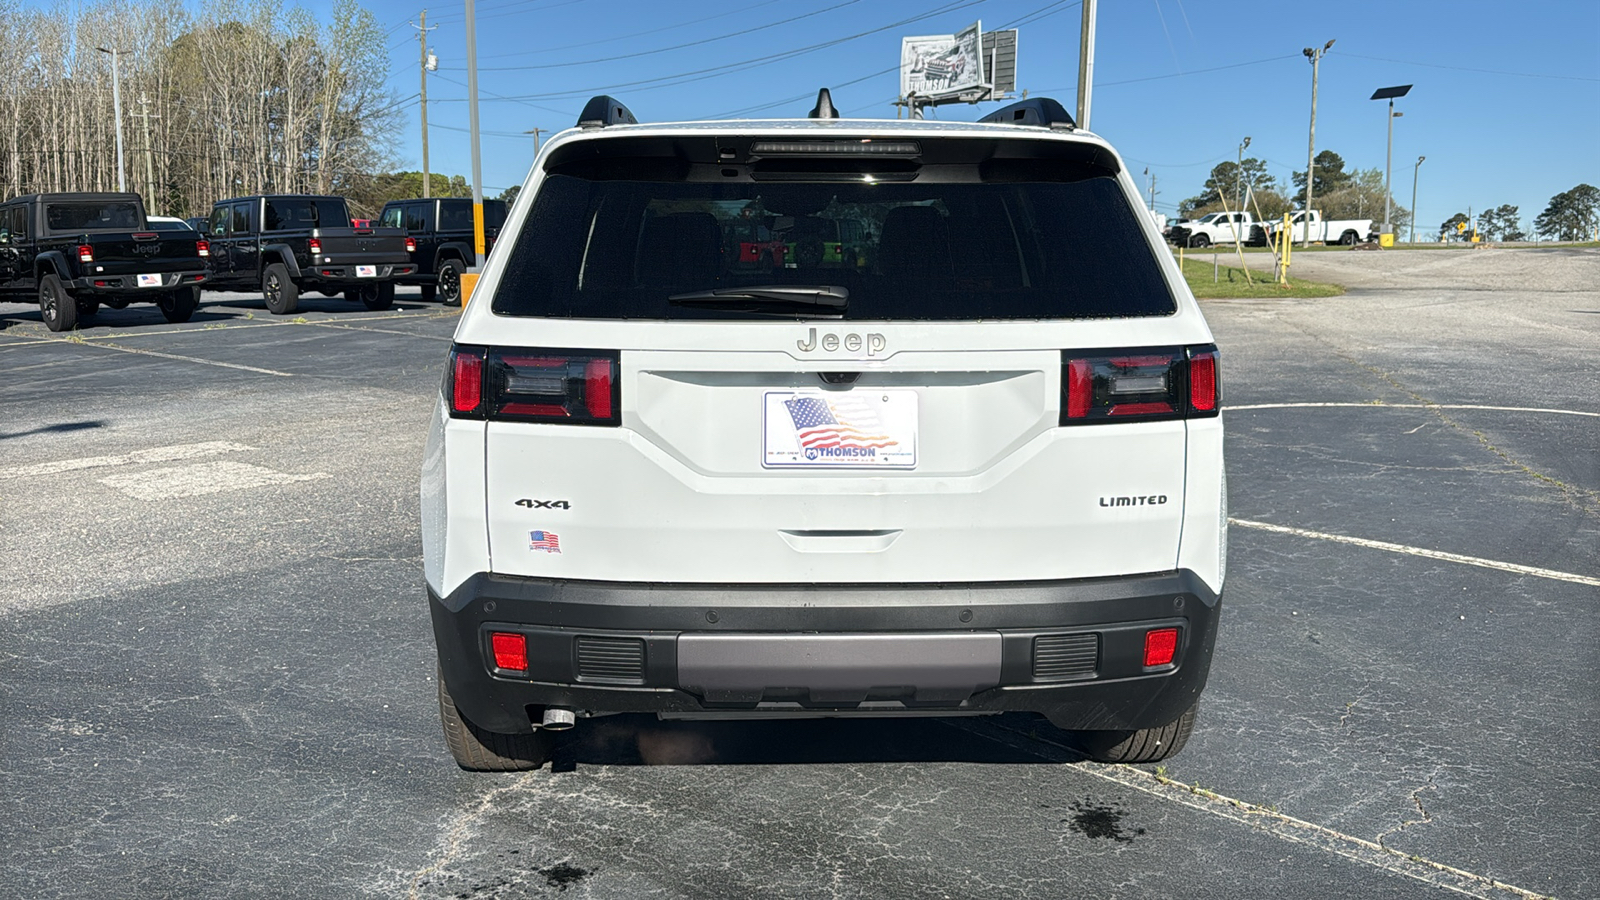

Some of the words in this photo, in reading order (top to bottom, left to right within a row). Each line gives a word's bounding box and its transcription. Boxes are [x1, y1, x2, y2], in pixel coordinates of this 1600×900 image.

[909, 78, 950, 92] THOMSON
[131, 243, 160, 254] Jeep
[796, 327, 887, 357] Jeep
[819, 447, 876, 457] THOMSON
[1099, 494, 1168, 507] LIMITED
